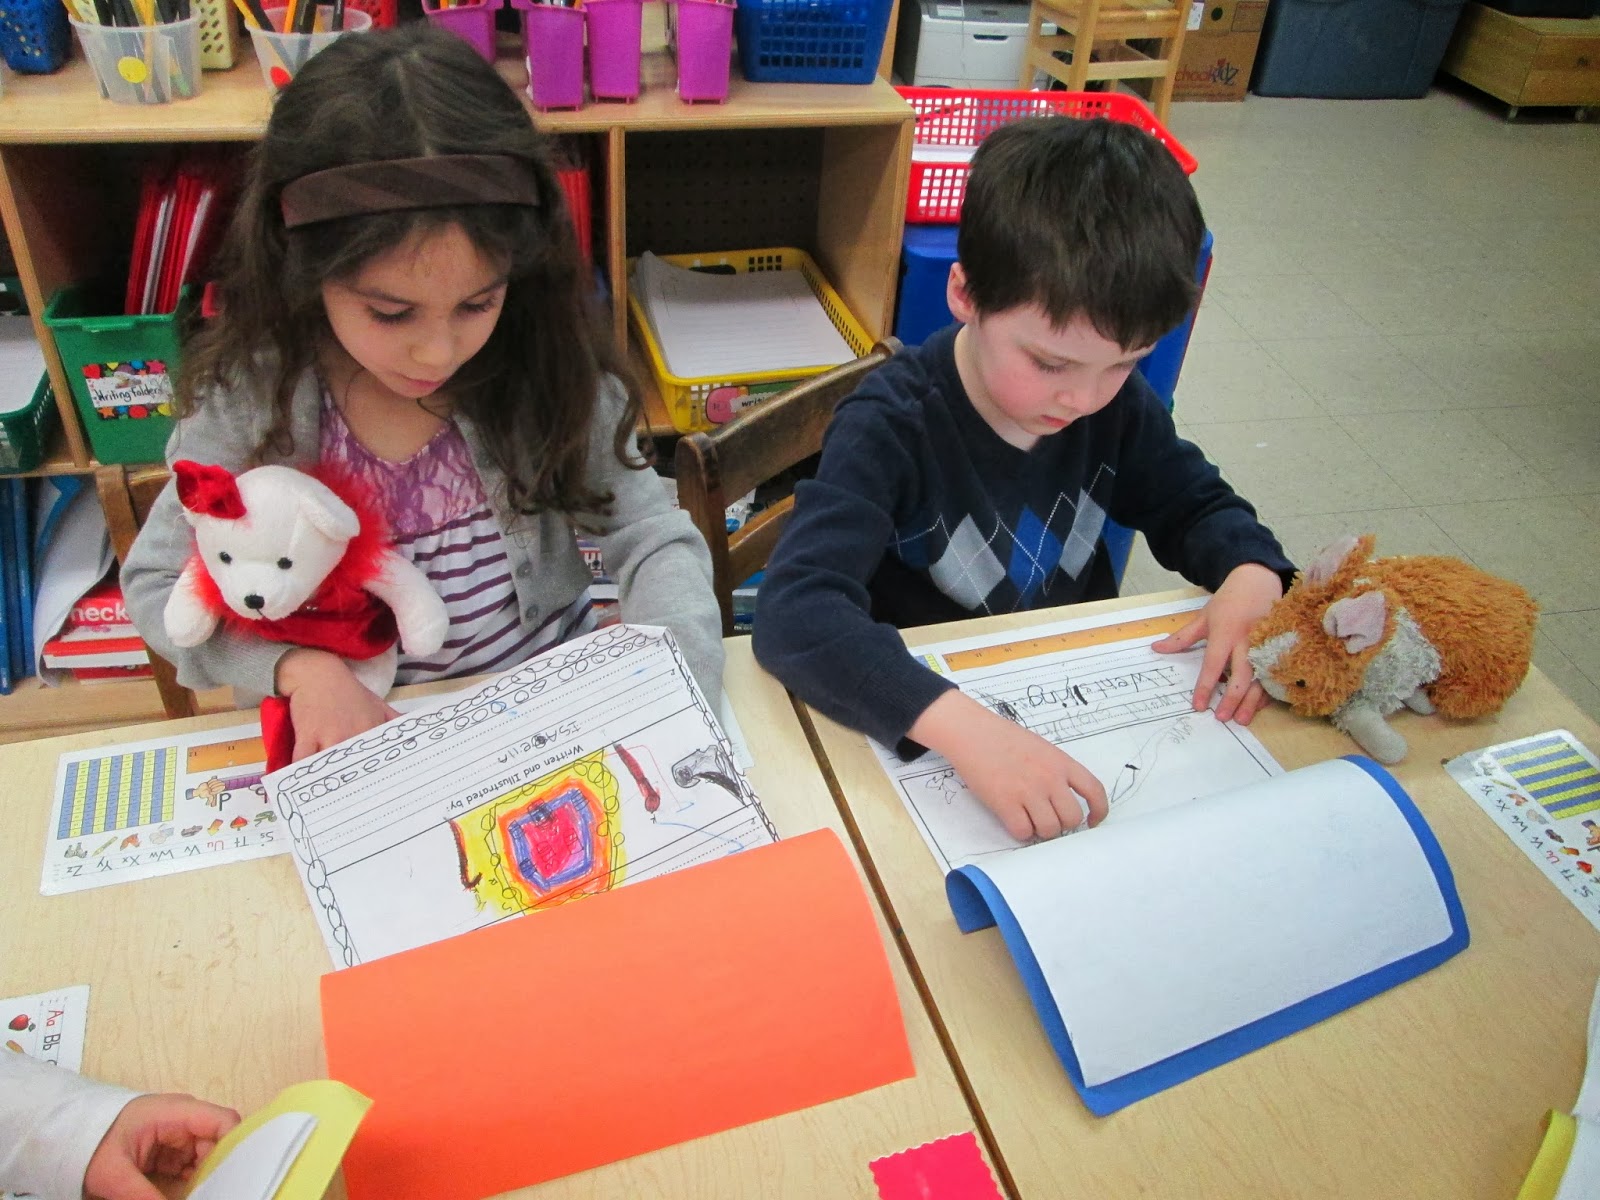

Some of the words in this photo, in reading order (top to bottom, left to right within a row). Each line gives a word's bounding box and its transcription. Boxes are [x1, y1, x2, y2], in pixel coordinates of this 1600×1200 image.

[94, 388, 132, 403] Writing
[544, 744, 584, 766] Written
[523, 763, 541, 775] and
[466, 773, 522, 805] Illustrated
[446, 800, 464, 812] by:
[184, 844, 201, 856] Vv
[207, 840, 225, 852] Uu
[122, 854, 140, 867] Xx
[149, 849, 175, 862] Ww
[97, 855, 113, 872] Yy
[66, 864, 83, 877] Zz
[46, 1010, 65, 1027] Aa
[43, 1033, 61, 1051] Bb
